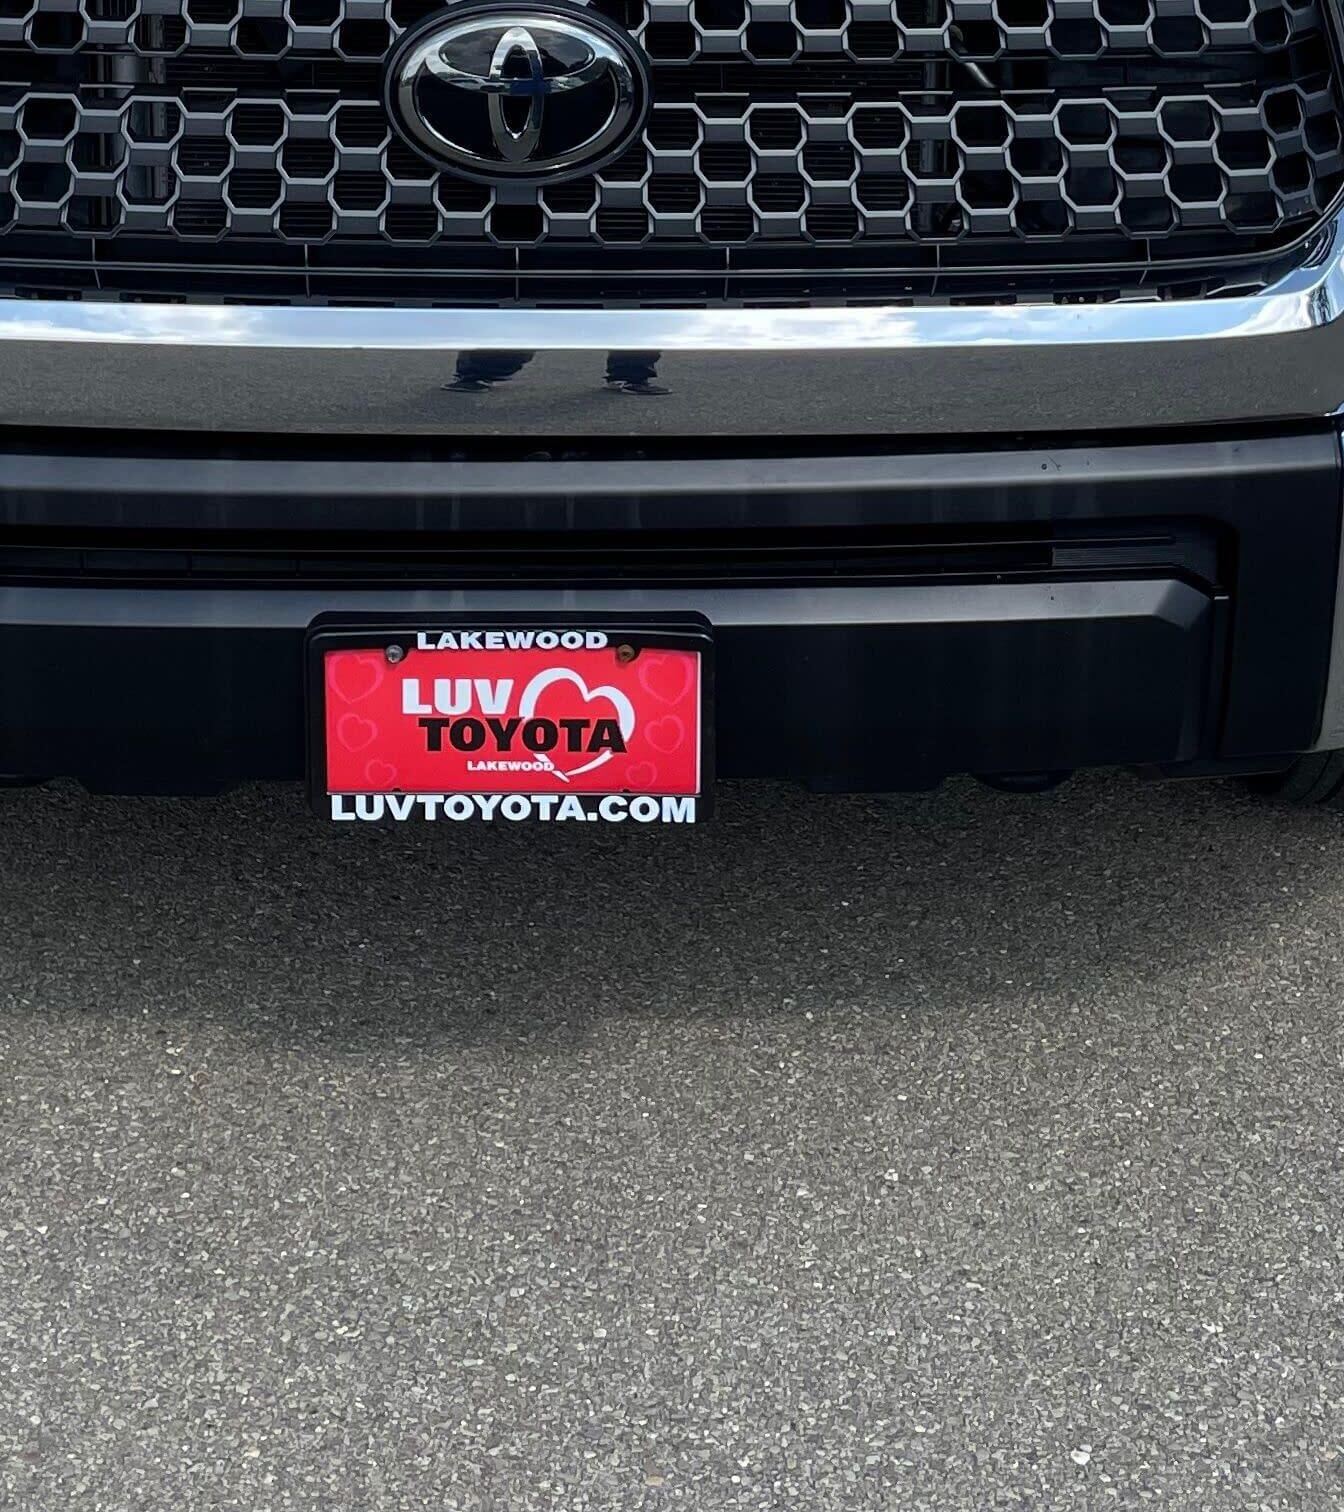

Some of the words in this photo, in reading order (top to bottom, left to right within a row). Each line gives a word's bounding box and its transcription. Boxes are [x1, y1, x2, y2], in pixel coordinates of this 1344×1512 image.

[417, 631, 609, 650] LAKEWOOD
[401, 678, 514, 716] LUV
[418, 717, 628, 754] TOYOTA
[467, 760, 555, 772] LAKEWOOD
[330, 794, 696, 824] LUVTOYOTA.COM
